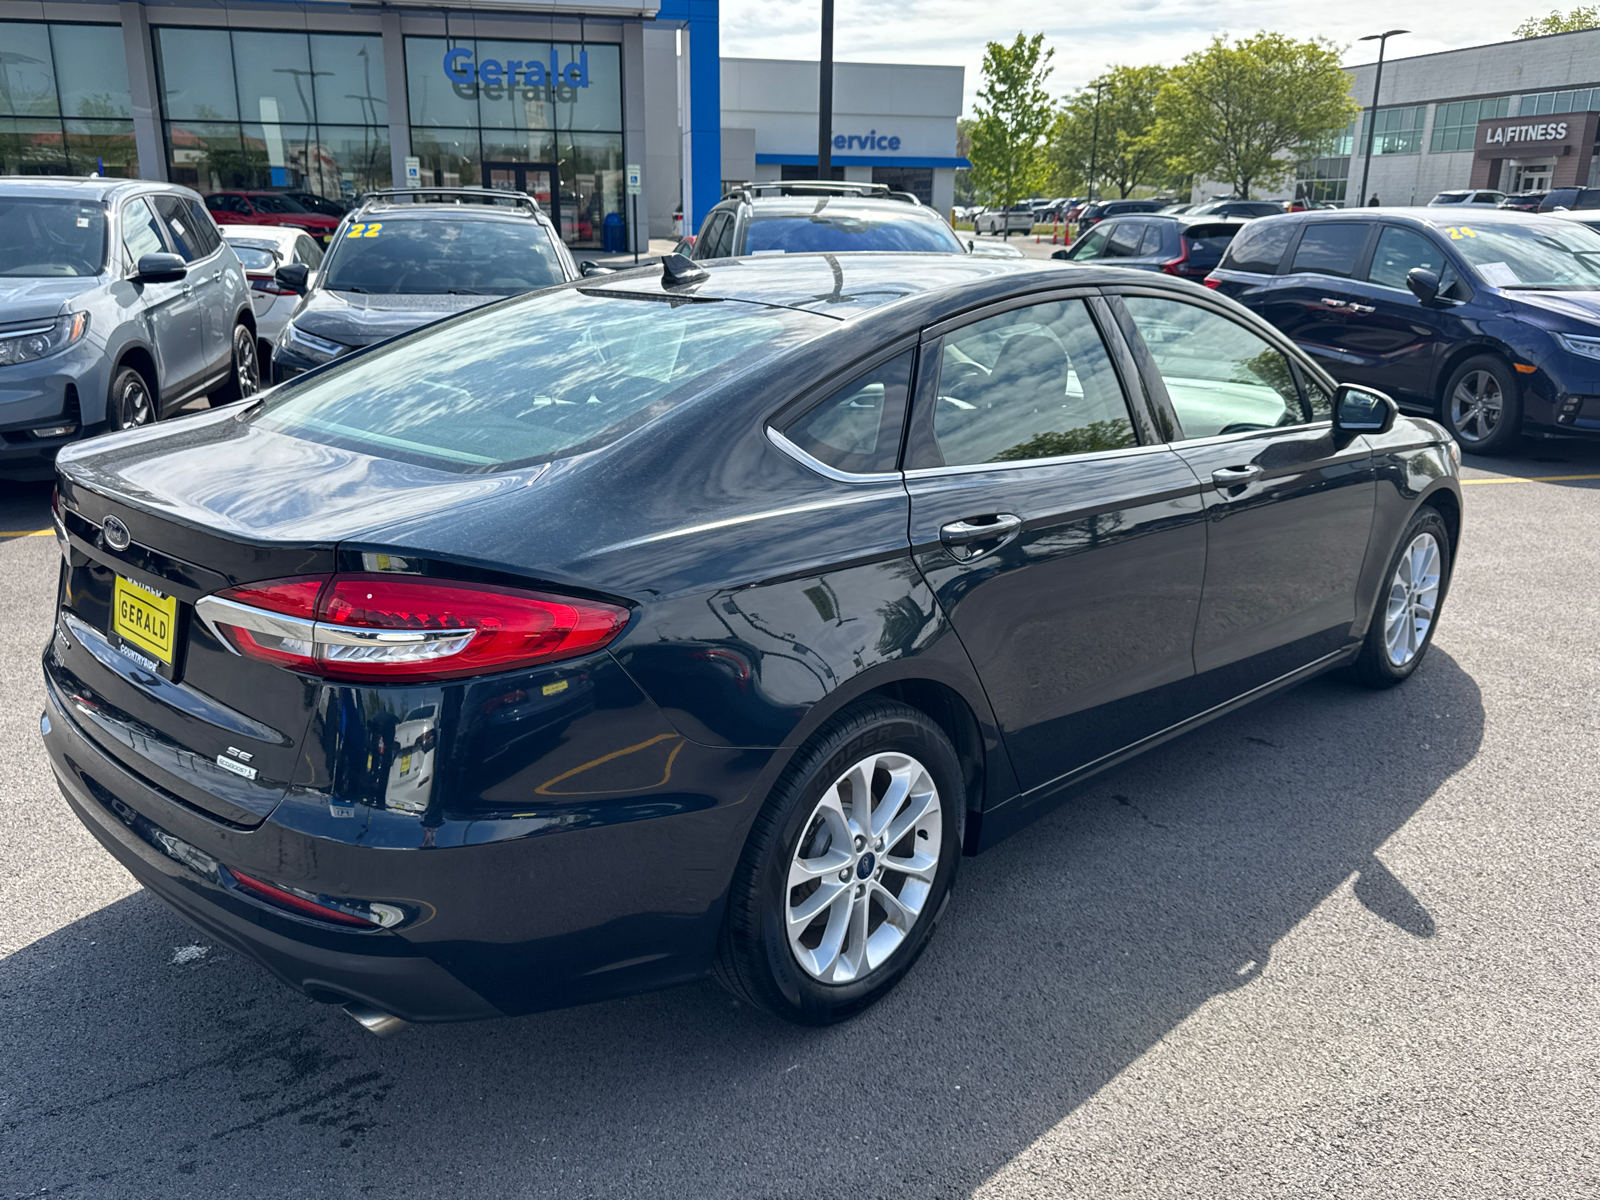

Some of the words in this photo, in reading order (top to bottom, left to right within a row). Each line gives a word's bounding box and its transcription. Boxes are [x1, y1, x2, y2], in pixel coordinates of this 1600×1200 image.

[443, 48, 589, 88] Gerald
[831, 129, 901, 150] ervice
[1506, 122, 1568, 142] FITNESS
[347, 223, 383, 238] 22
[121, 600, 166, 640] GERALD
[120, 644, 158, 672] COUNTRYSIDE
[226, 746, 253, 762] SE
